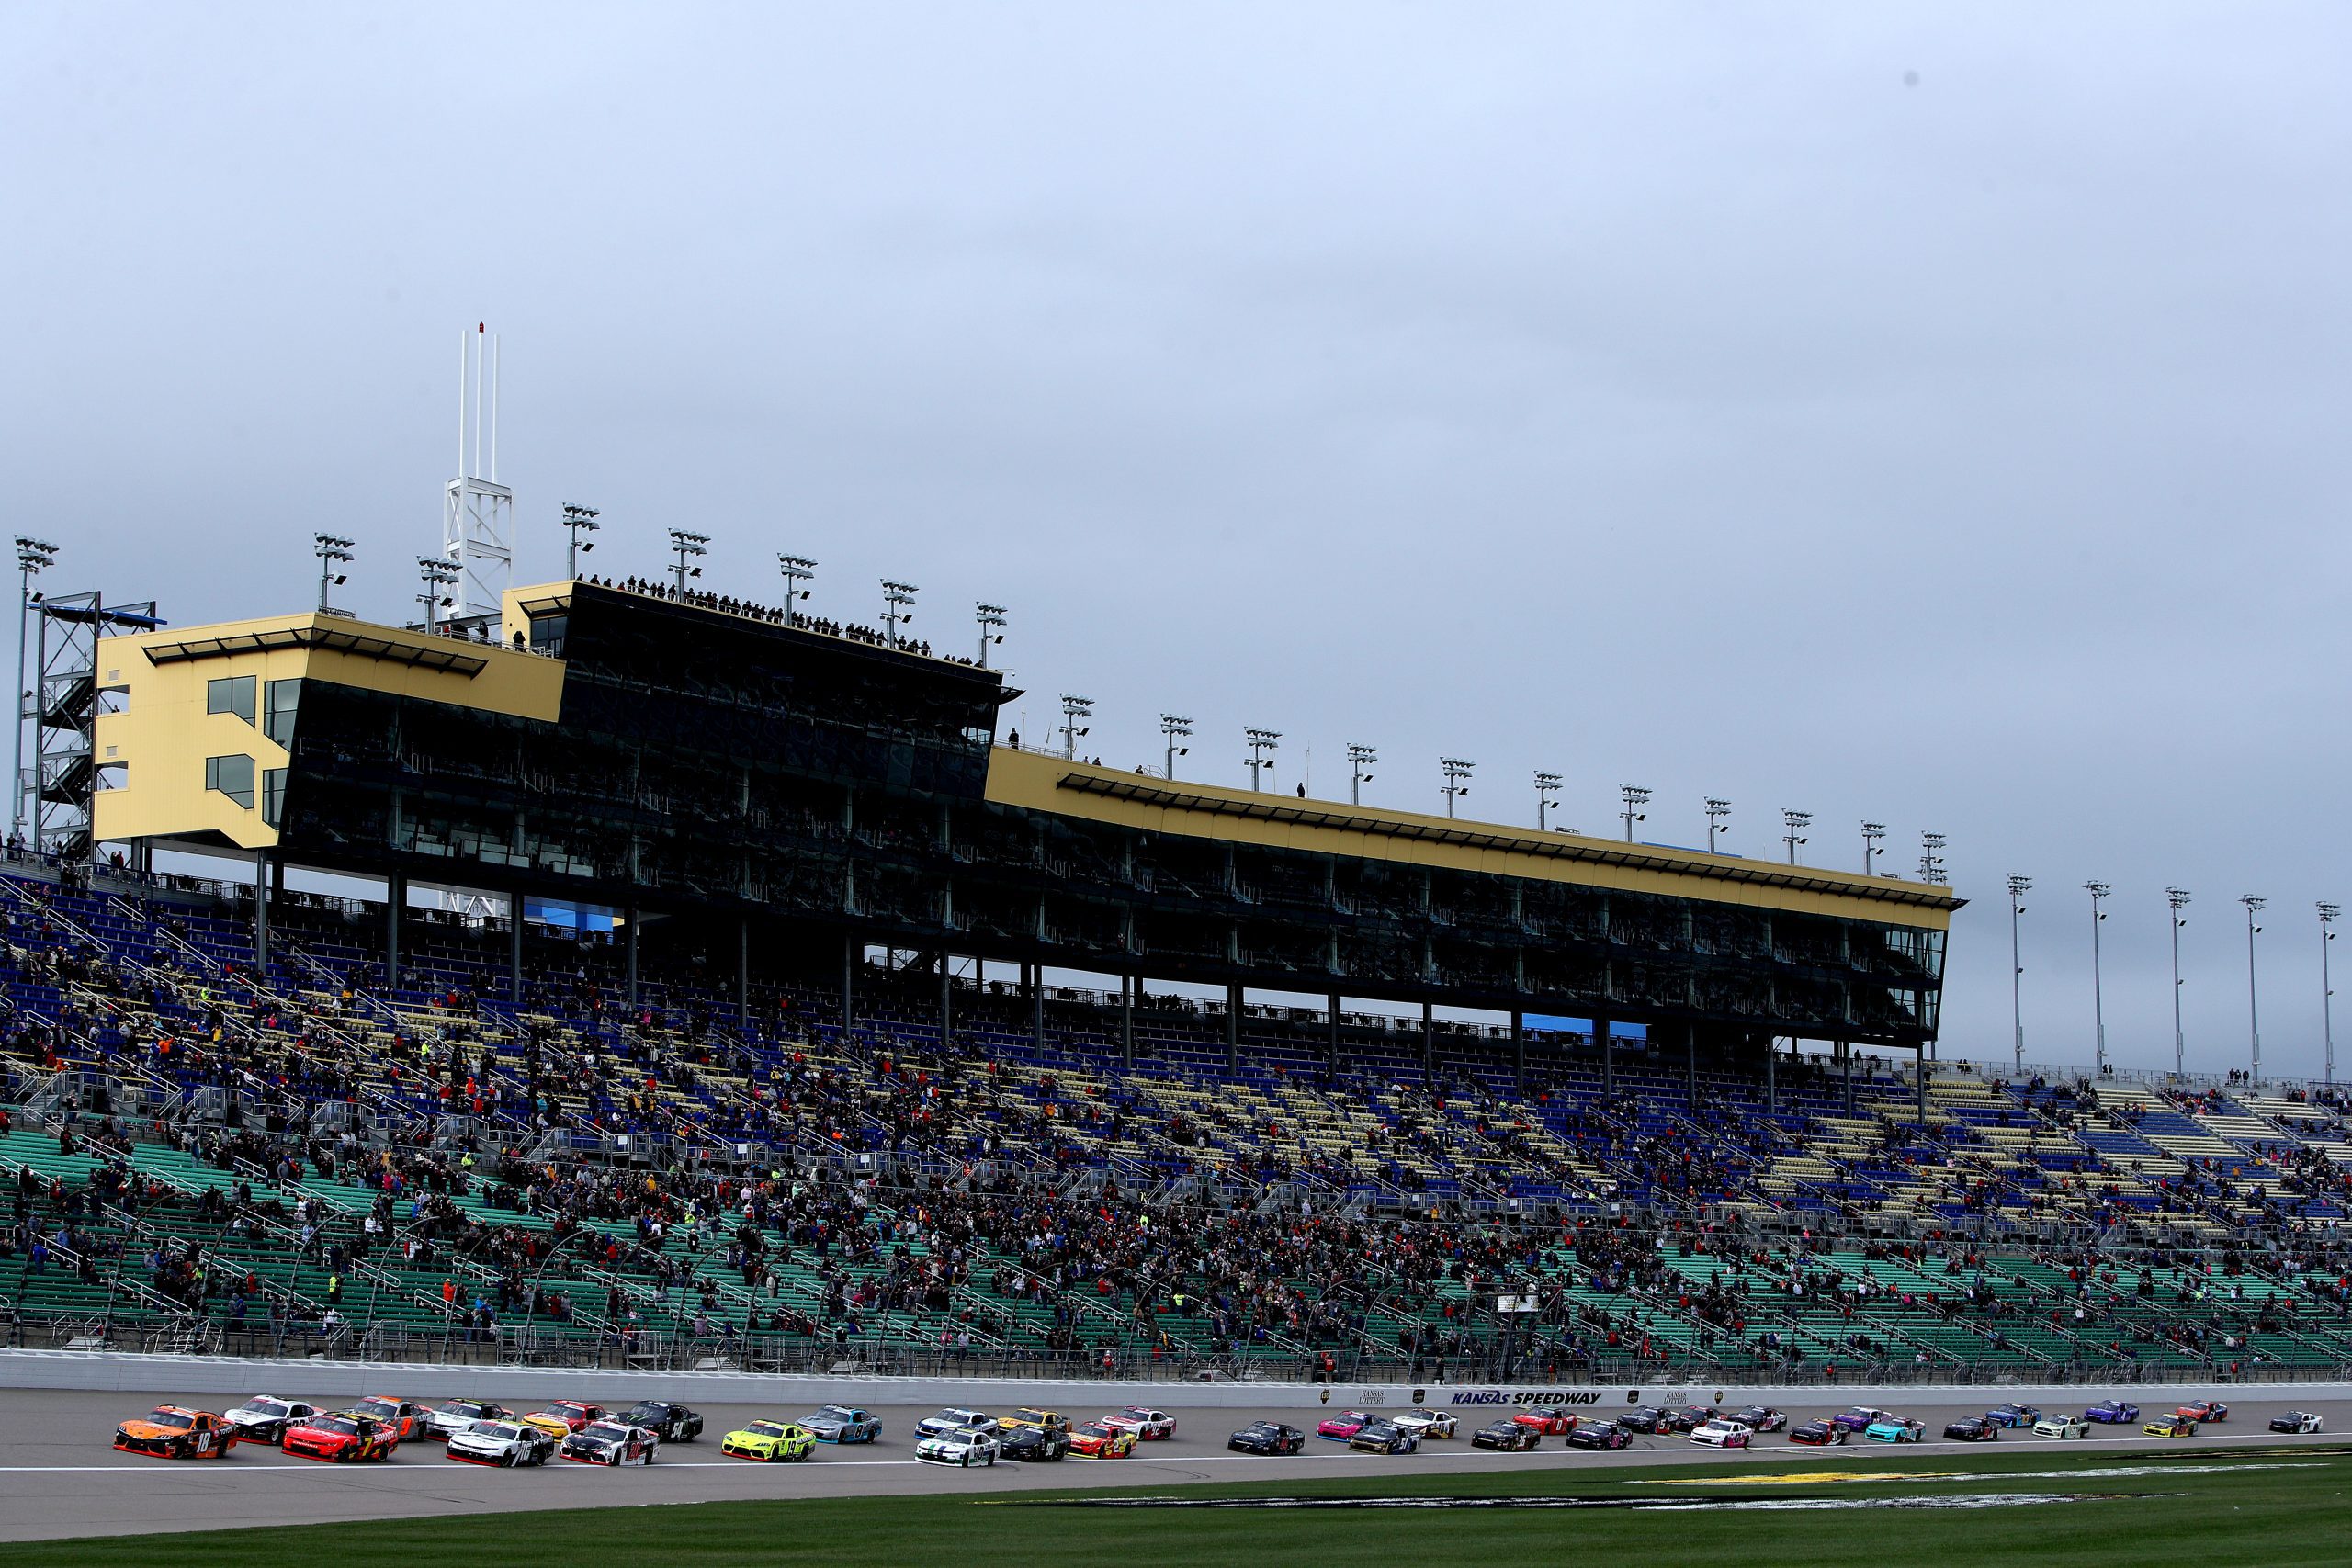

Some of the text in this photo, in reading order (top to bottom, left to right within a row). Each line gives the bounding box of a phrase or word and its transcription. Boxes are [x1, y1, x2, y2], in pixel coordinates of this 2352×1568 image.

[1451, 1390, 1601, 1404] KANSAS SPEEDWAY
[399, 1417, 412, 1436] 9
[670, 1421, 684, 1438] 54
[854, 1423, 864, 1439] 8
[196, 1432, 211, 1453] 18
[361, 1437, 373, 1457] 7
[519, 1440, 533, 1462] 16
[628, 1441, 641, 1461] 20
[786, 1440, 797, 1458] 19
[1113, 1439, 1120, 1454] 2
